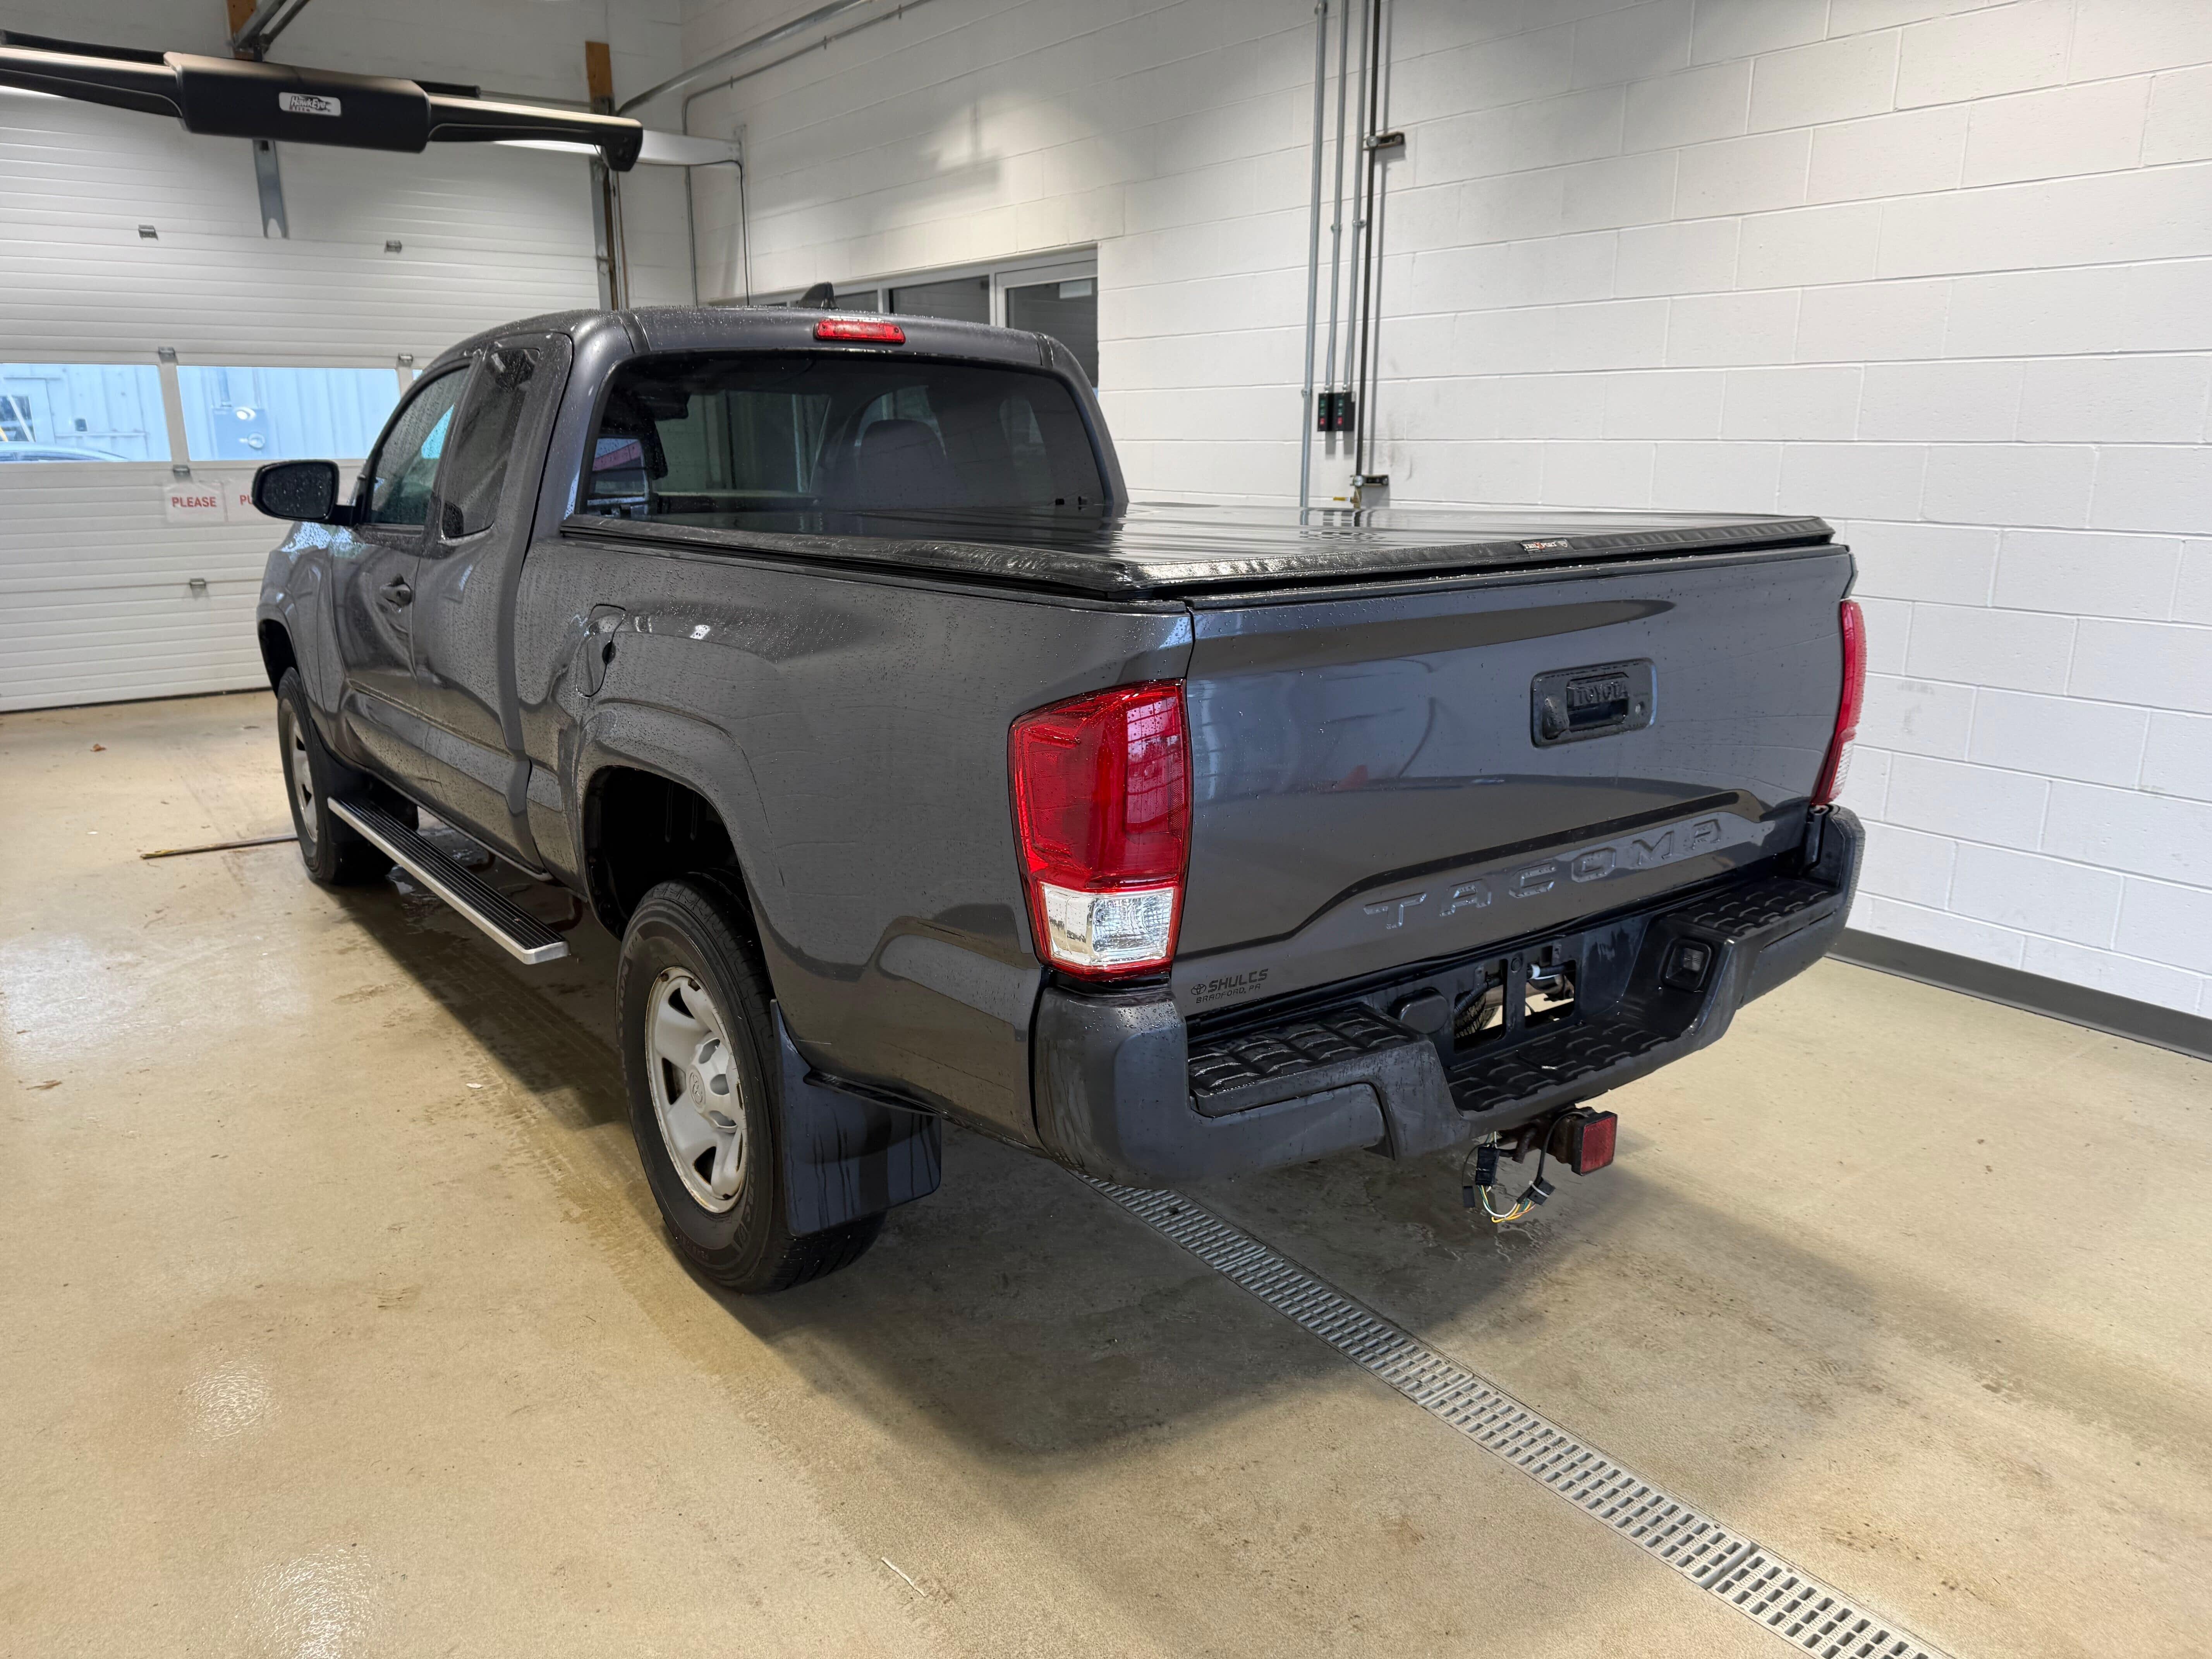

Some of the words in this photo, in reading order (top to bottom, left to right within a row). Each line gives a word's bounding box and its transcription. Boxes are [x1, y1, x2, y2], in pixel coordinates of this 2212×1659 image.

[290, 96, 326, 110] HawkEye
[172, 496, 217, 507] PLEASE
[1577, 680, 1628, 704] TOYOTA
[1363, 819, 1722, 929] TACOMA
[1196, 987, 1246, 1004] BRADFORD,
[1249, 983, 1261, 991] PA
